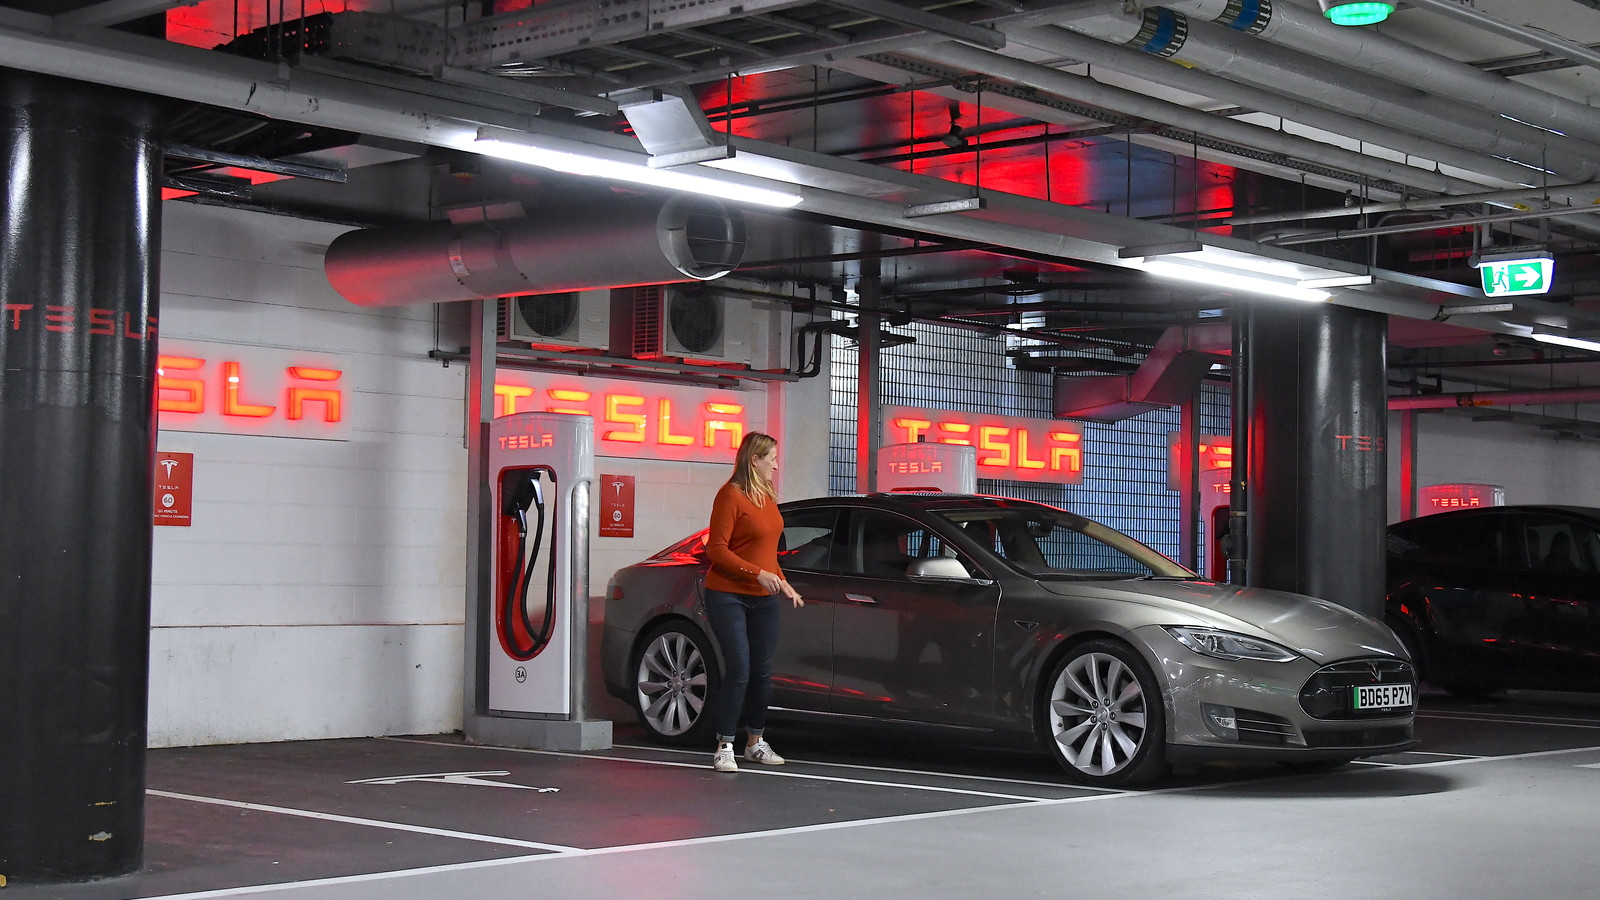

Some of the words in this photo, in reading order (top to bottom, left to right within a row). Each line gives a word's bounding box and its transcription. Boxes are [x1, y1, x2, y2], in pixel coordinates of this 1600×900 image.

[157, 355, 342, 422] SLA
[494, 384, 744, 449] TESLA
[498, 433, 554, 450] TESLA
[893, 418, 1081, 473] TESLA
[1334, 434, 1385, 452] TES
[888, 461, 942, 475] TESLA
[1431, 498, 1480, 508] TESLA
[1360, 687, 1390, 707] BD65
[1392, 686, 1410, 705] PZY
